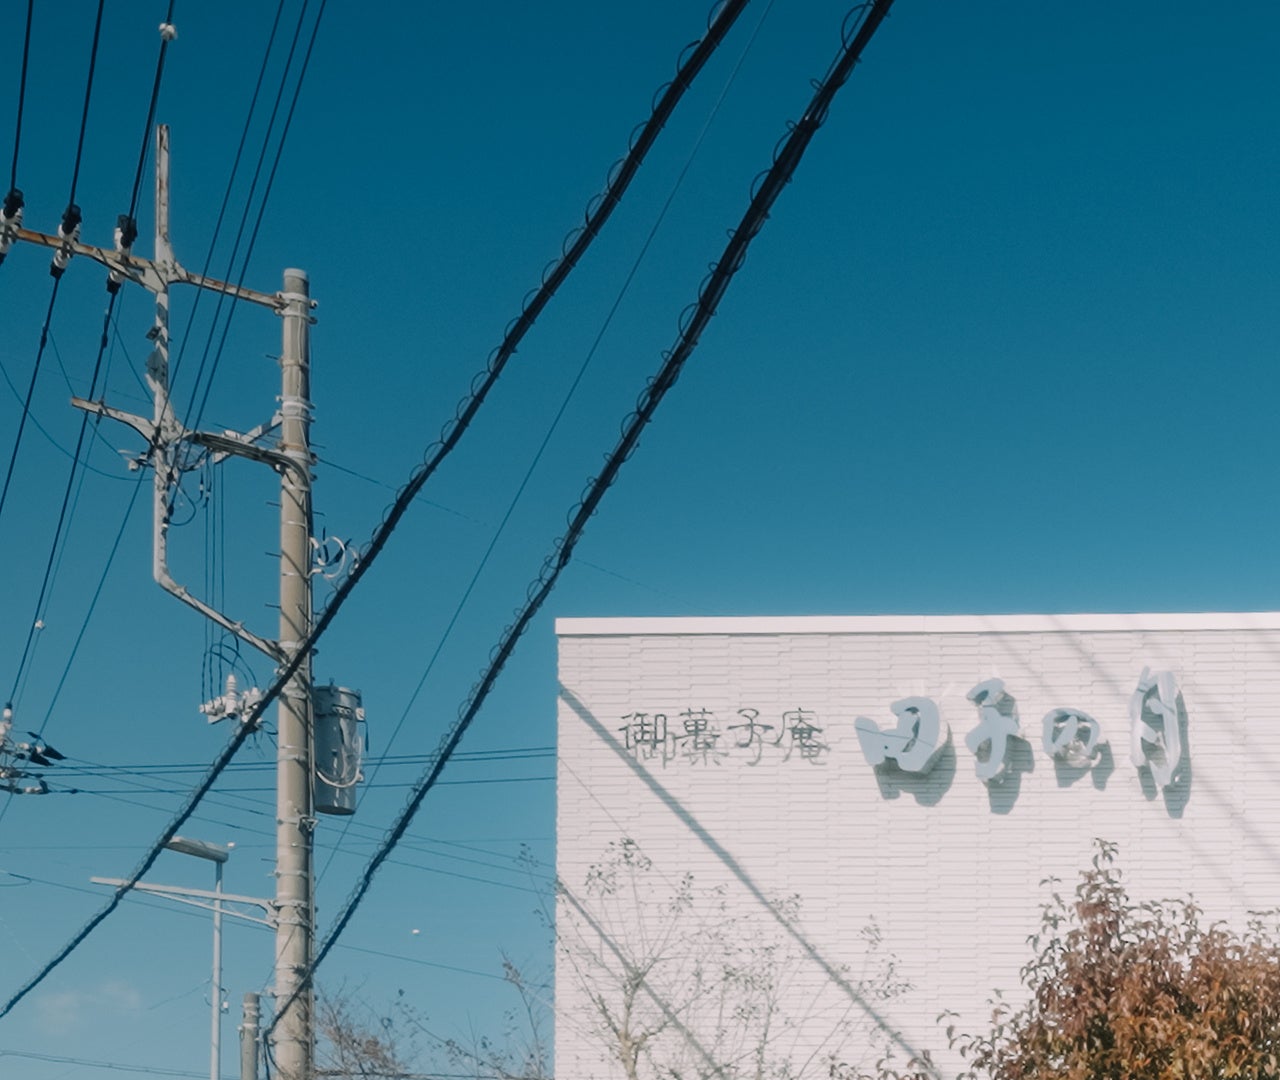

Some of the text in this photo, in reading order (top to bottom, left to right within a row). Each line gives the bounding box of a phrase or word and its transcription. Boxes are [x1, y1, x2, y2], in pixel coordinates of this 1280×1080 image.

[619, 706, 826, 758] 御菓子庵
[854, 666, 1184, 790] 田子の月
